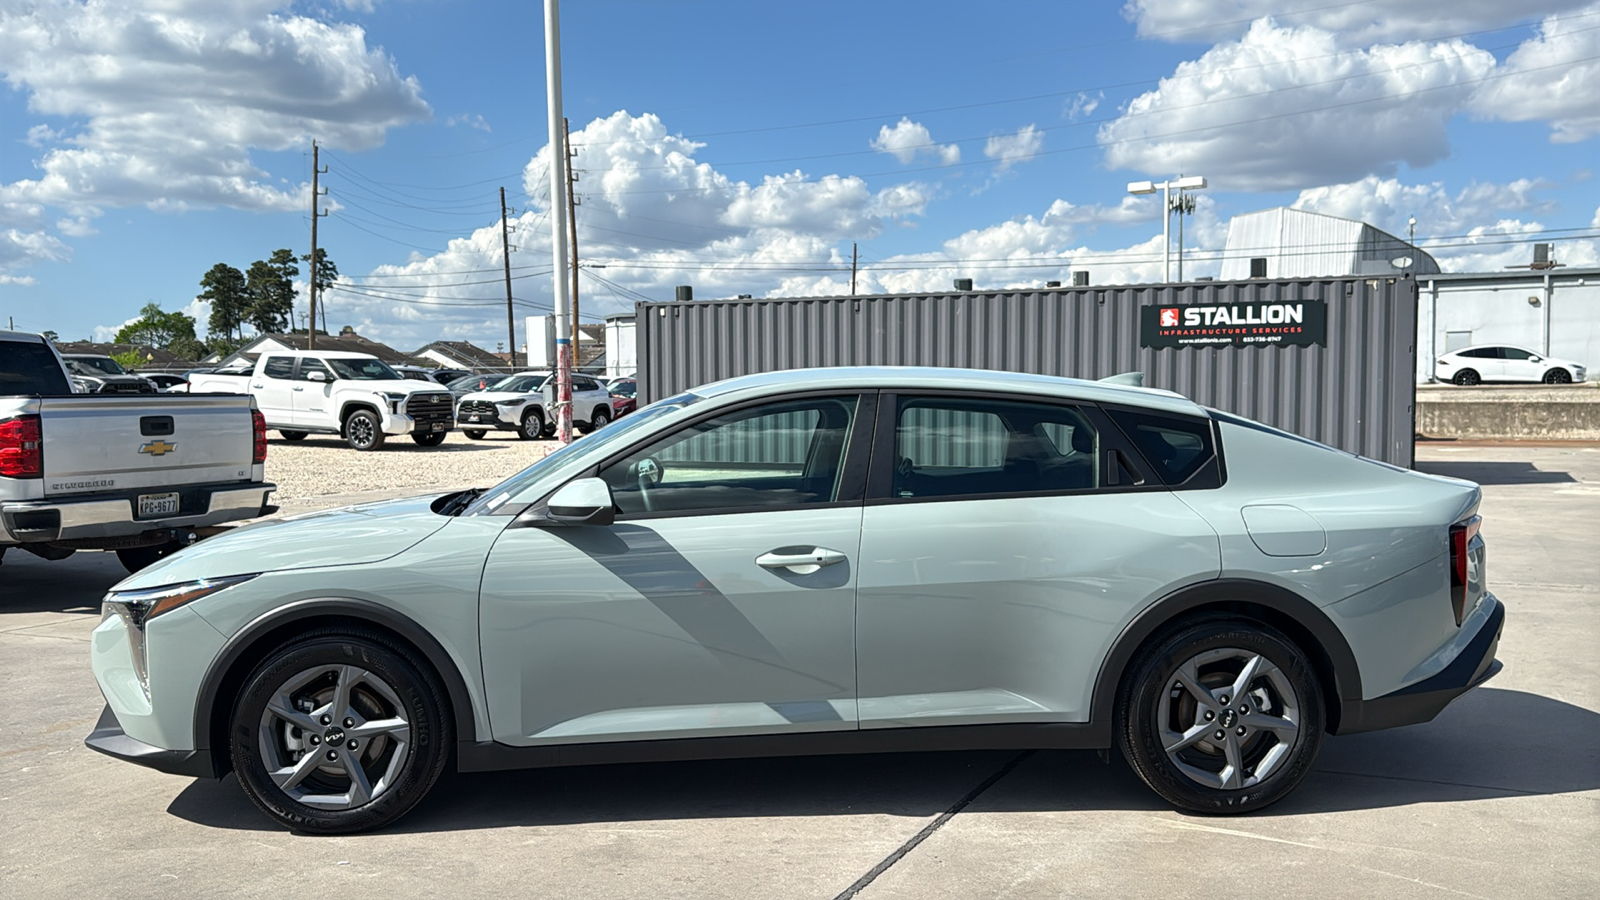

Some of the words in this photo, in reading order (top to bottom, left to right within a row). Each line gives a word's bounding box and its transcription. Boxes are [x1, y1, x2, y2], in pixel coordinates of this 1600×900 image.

[1184, 304, 1303, 326] STALLION
[1159, 328, 1247, 336] INFRASTRUCTURE
[1252, 326, 1302, 335] SERVICES
[52, 480, 115, 490] SILVERADO
